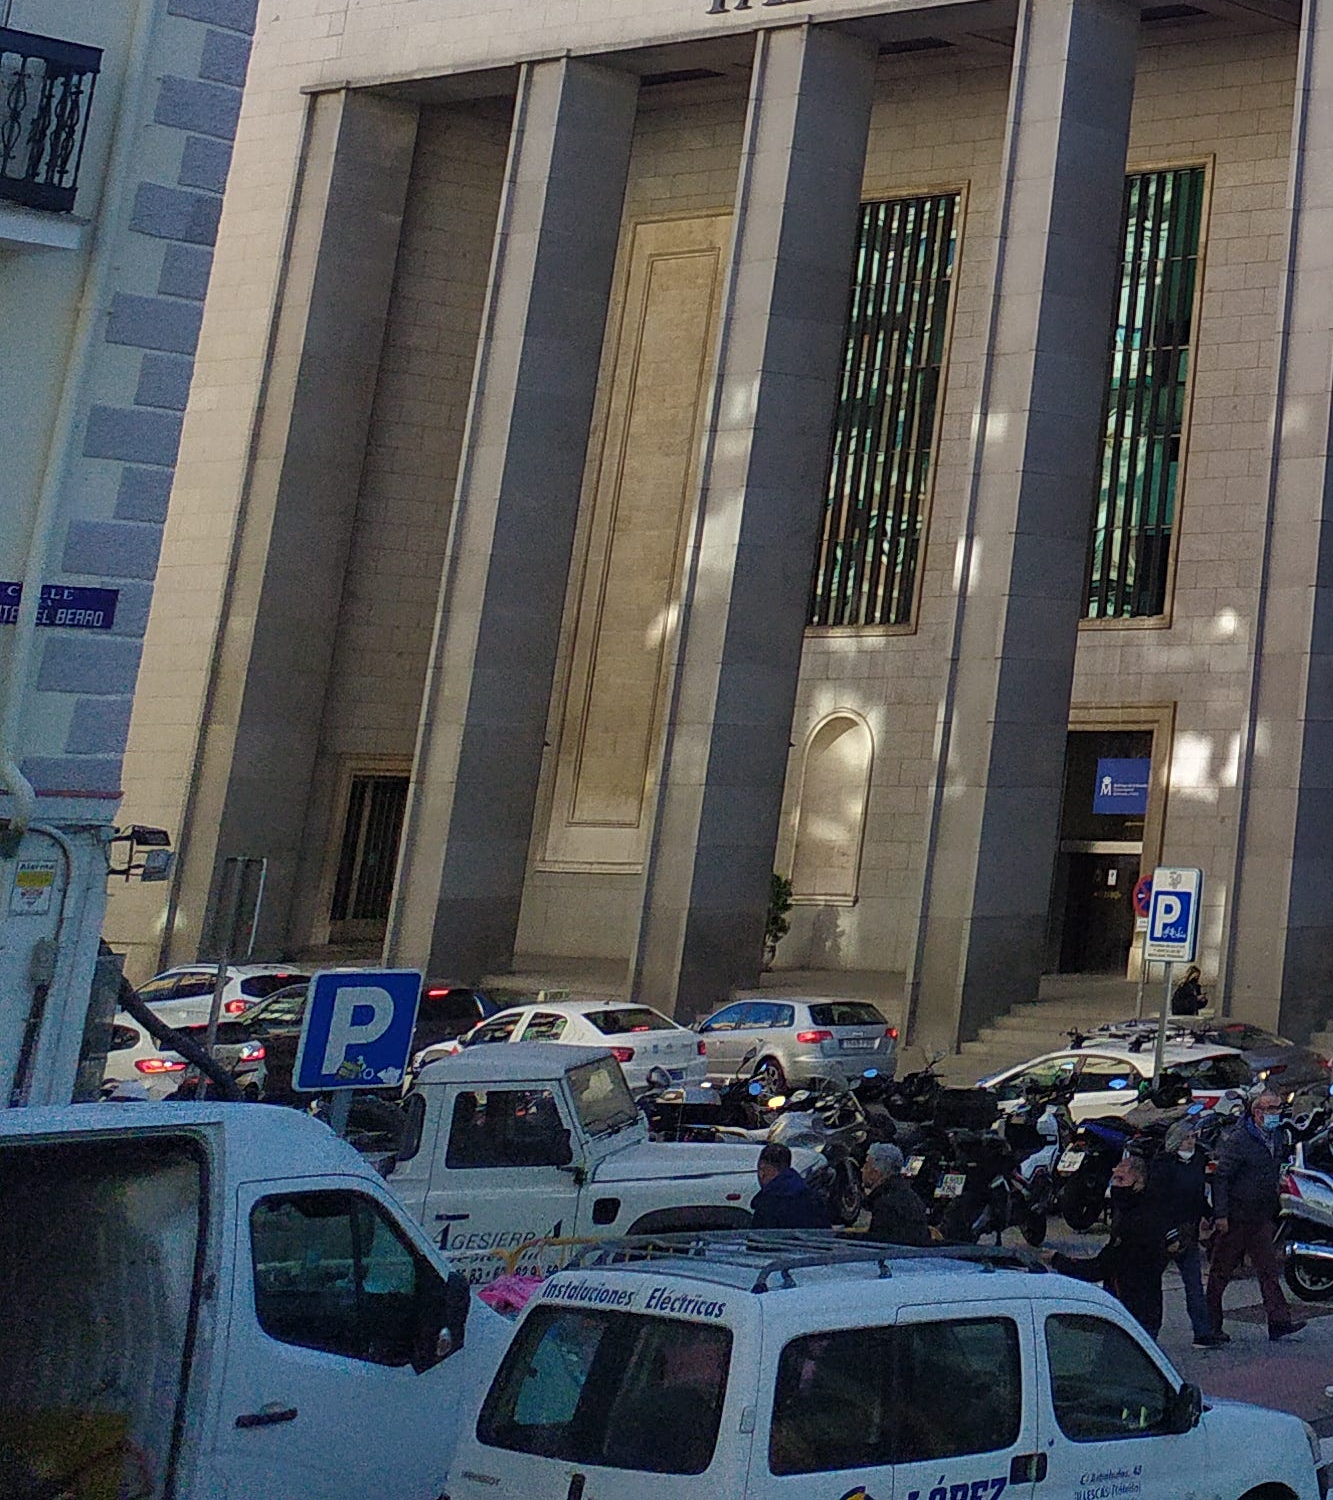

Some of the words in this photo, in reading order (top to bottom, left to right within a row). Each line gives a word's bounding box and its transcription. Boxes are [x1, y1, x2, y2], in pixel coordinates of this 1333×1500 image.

[6, 585, 75, 600] CLE
[55, 608, 104, 627] BERRO
[1154, 895, 1181, 937] P
[321, 986, 395, 1075] P
[645, 1287, 728, 1318] Eléctricas
